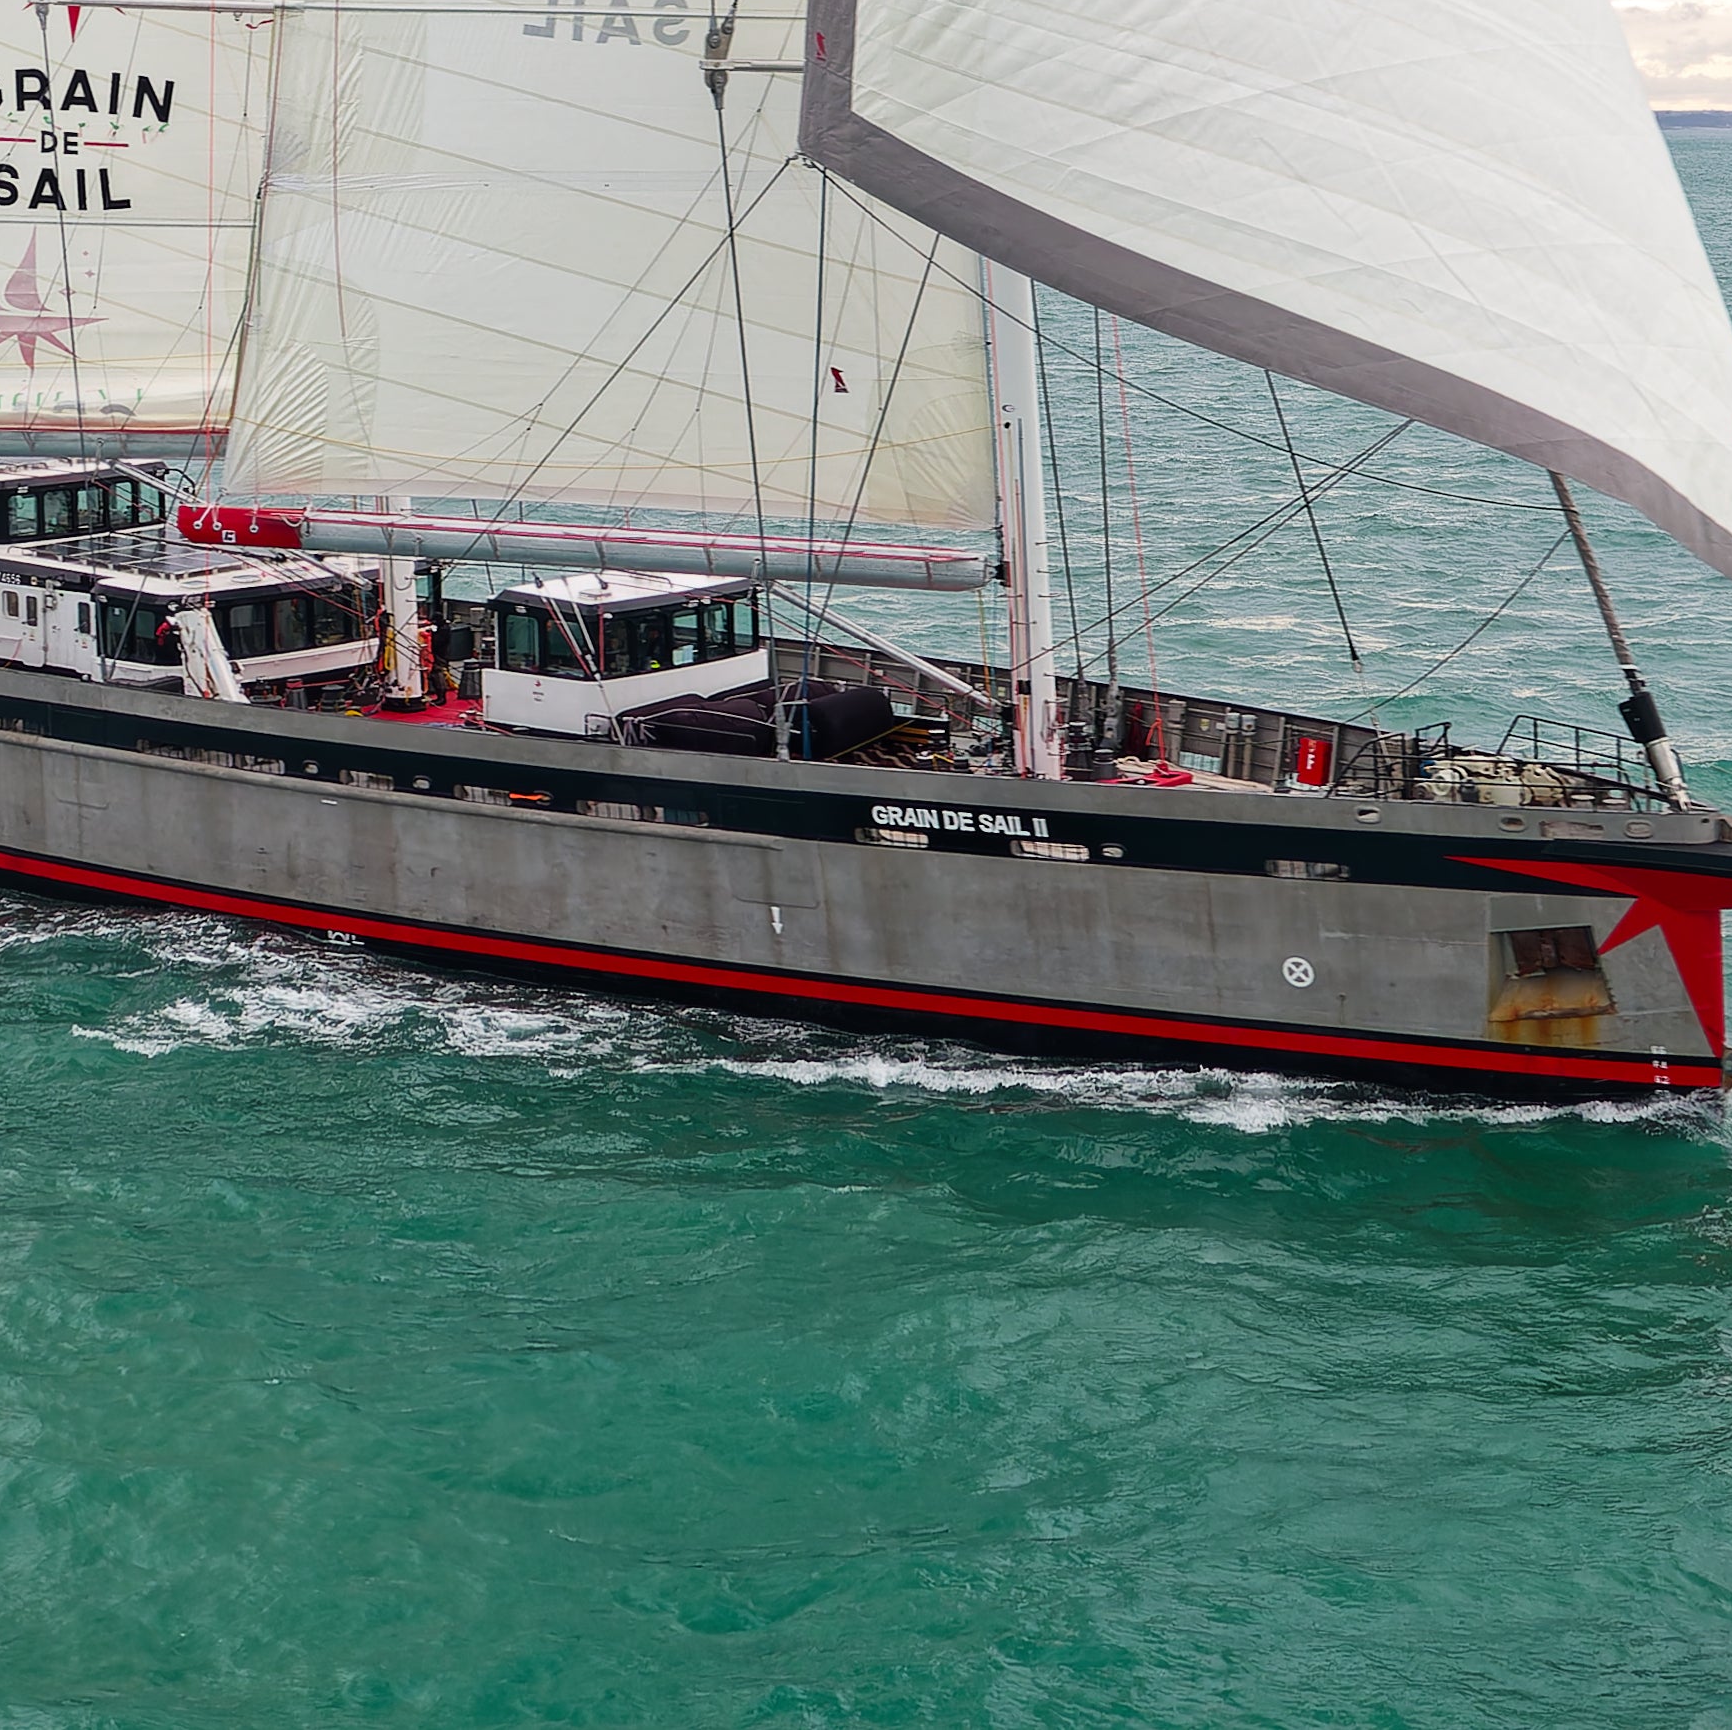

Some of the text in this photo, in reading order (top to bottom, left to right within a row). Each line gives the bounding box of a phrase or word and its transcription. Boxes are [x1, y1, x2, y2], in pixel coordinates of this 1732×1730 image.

[40, 130, 80, 155] DE
[871, 805, 1049, 838] GRAIN DE SAIL II
